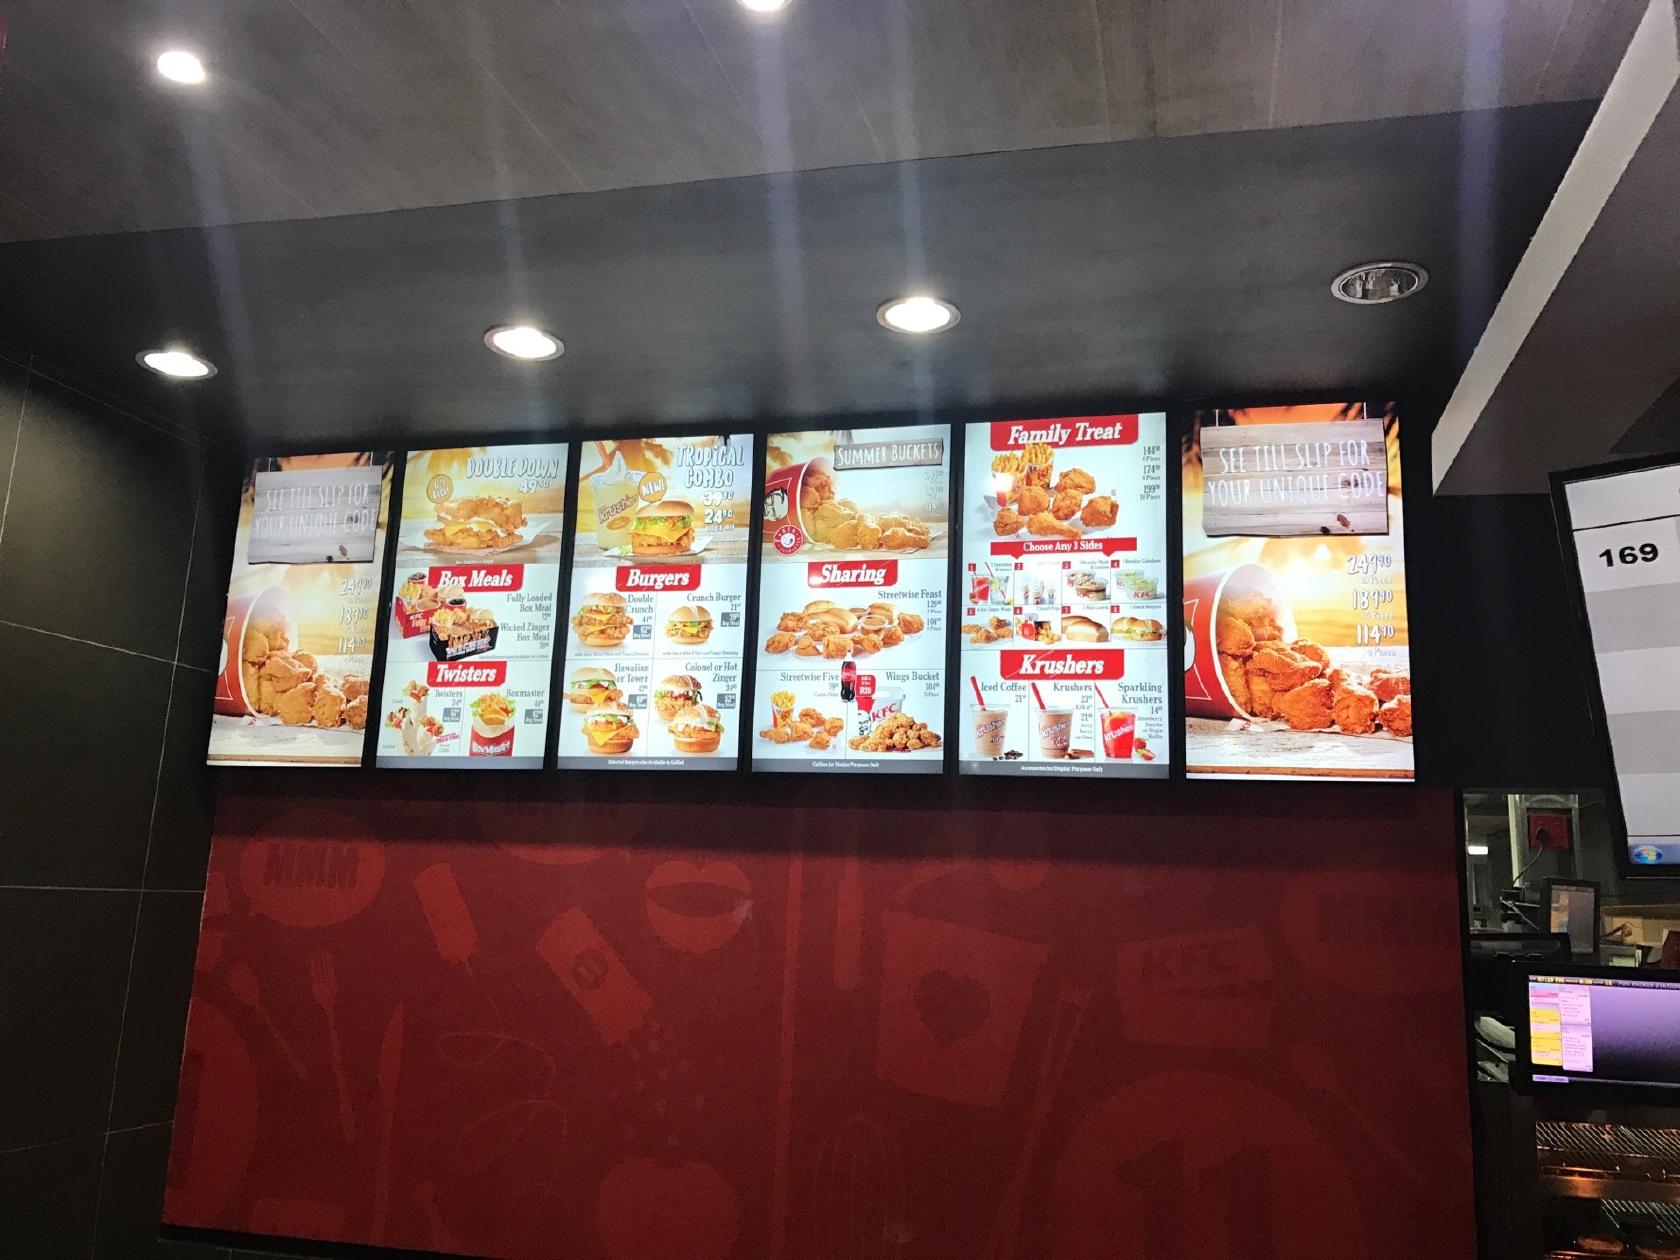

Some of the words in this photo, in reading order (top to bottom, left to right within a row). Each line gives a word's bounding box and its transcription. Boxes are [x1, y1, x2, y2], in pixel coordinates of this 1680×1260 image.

[1008, 424, 1072, 446] Family
[1075, 422, 1123, 442] Treat
[676, 445, 745, 467] TROPICAL
[837, 447, 887, 466] SUMMER
[891, 442, 939, 461] BUCKETS
[1219, 447, 1247, 474] SEE
[1253, 443, 1288, 472] TILL
[1295, 440, 1332, 469] SLIP
[1339, 438, 1370, 466] FOR
[466, 457, 517, 479] DOUBLE
[517, 456, 560, 479] DOWN
[685, 467, 734, 488] COMBO
[641, 479, 665, 496] NEW!
[1207, 478, 1250, 507] YOUR
[1259, 473, 1330, 505] UNIQUE
[1338, 471, 1385, 499] CODE
[1023, 541, 1053, 552] Choose
[1055, 541, 1072, 553] Any
[1073, 541, 1078, 550] 3
[1079, 540, 1104, 551] Sides
[1598, 542, 1660, 568] 169
[438, 571, 467, 588] Box
[468, 569, 514, 588] Meals
[626, 569, 690, 589] Burgers
[820, 563, 887, 585] Sharing
[527, 592, 552, 602] Loaded
[628, 594, 654, 603] Double
[687, 593, 714, 602] Crunch
[716, 592, 742, 602] Burger
[878, 590, 920, 599] Streetwise
[920, 589, 942, 599] Feast
[535, 603, 552, 612] Meal
[626, 605, 654, 614] Crunch
[500, 622, 525, 632] Wicked
[527, 622, 550, 632] Zinger
[533, 632, 550, 641] Meal
[614, 663, 649, 672] Hawaiian
[685, 662, 712, 672] Colonel
[724, 662, 738, 671] Hot
[1019, 654, 1105, 675] Krushers
[435, 664, 497, 683] Twisters
[712, 674, 737, 682] Zinger
[780, 672, 820, 682] Streetwise
[822, 672, 840, 681] Five
[886, 672, 910, 682] Wings
[912, 672, 940, 680] Bucket
[981, 682, 998, 692] Iced
[1000, 682, 1026, 692] Coffee
[1053, 682, 1092, 692] Krushers
[1118, 682, 1162, 694] Sparkling
[435, 690, 463, 698] Twisters
[506, 689, 544, 698] Boxmaster
[1122, 694, 1162, 704] Krushers
[872, 703, 897, 721] KFC
